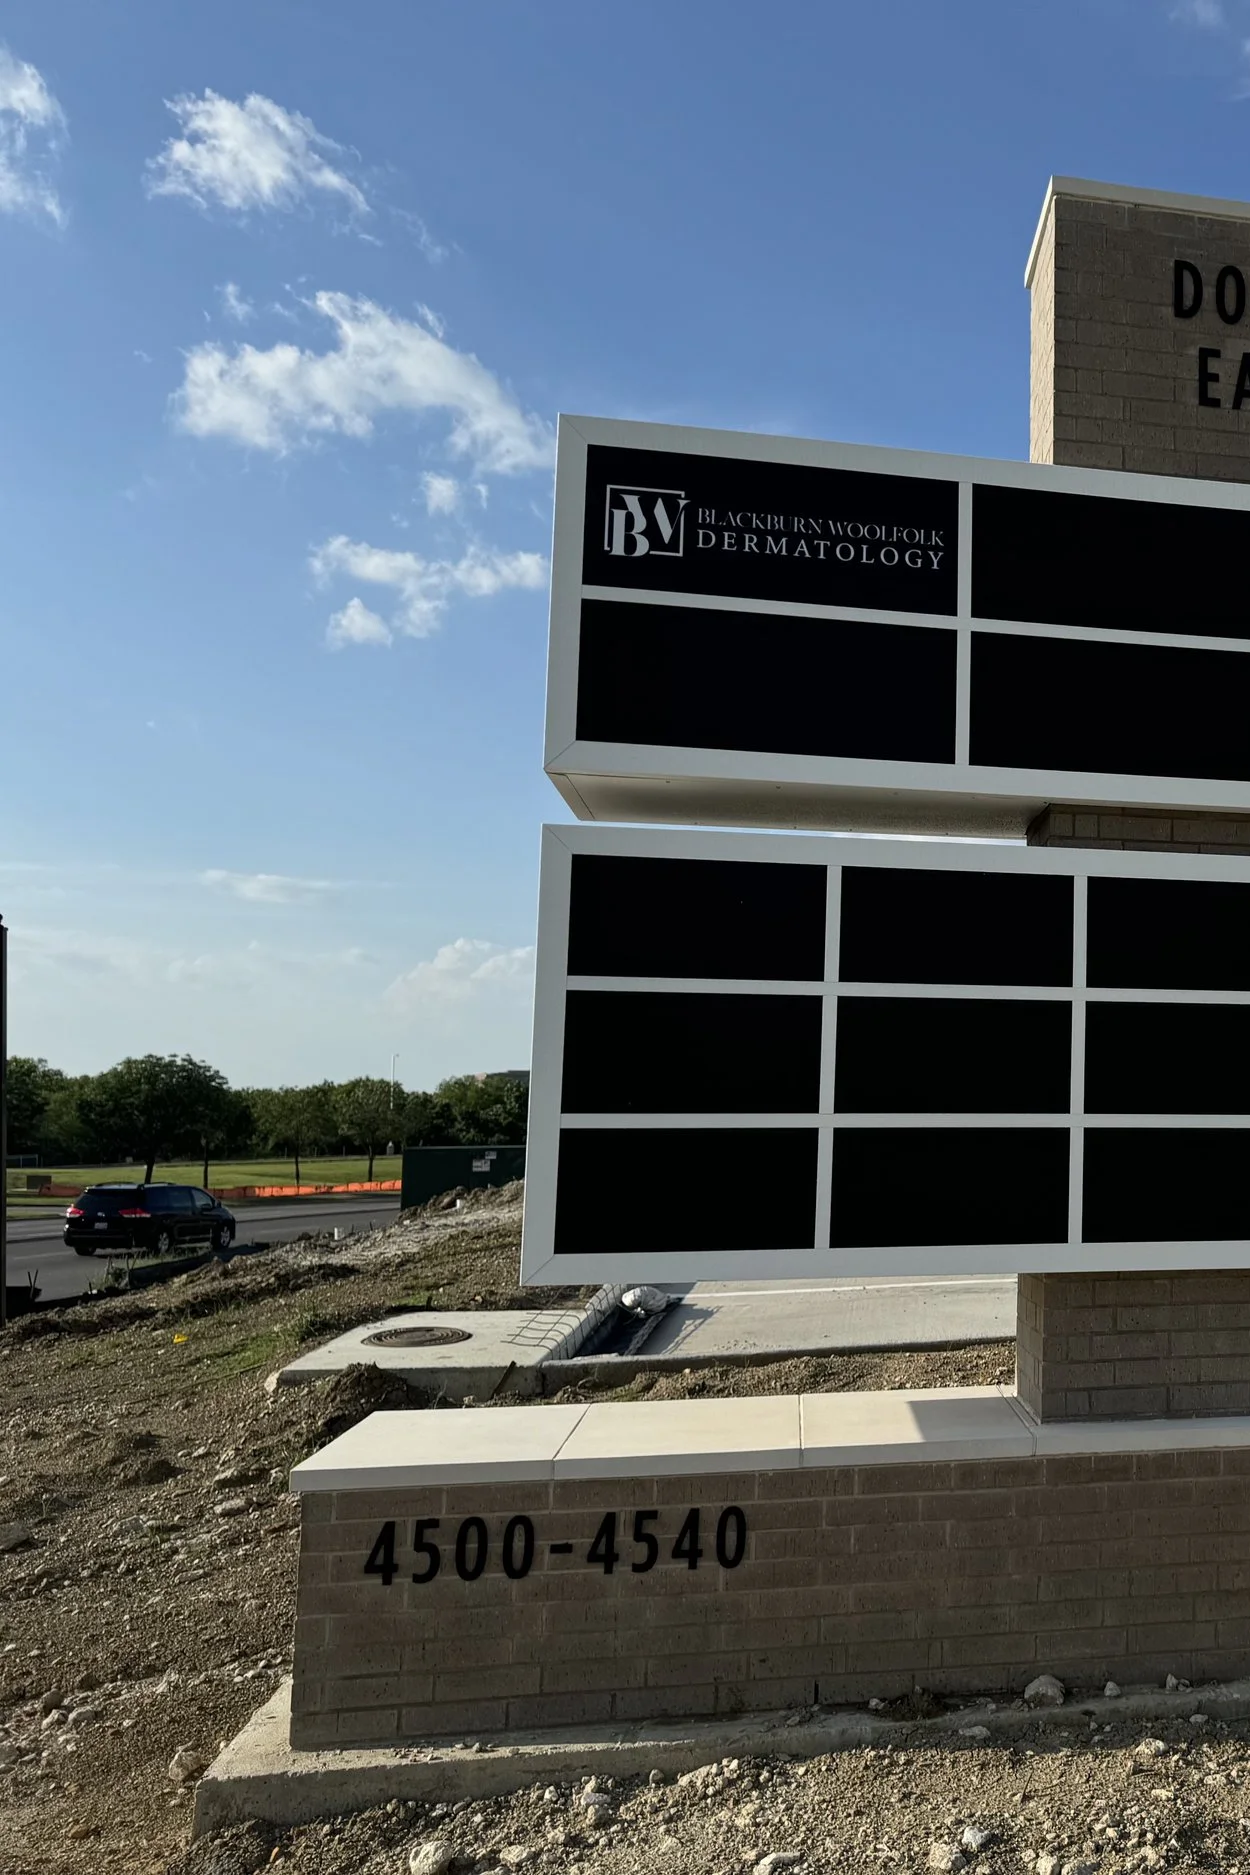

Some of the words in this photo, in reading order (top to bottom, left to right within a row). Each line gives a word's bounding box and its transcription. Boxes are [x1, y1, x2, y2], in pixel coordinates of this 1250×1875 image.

[697, 507, 822, 534] BLACKBURN
[828, 519, 945, 547] WOOLFOLK
[696, 529, 945, 570] DERMATOLOGY
[363, 1504, 747, 1586] 4500-4540
